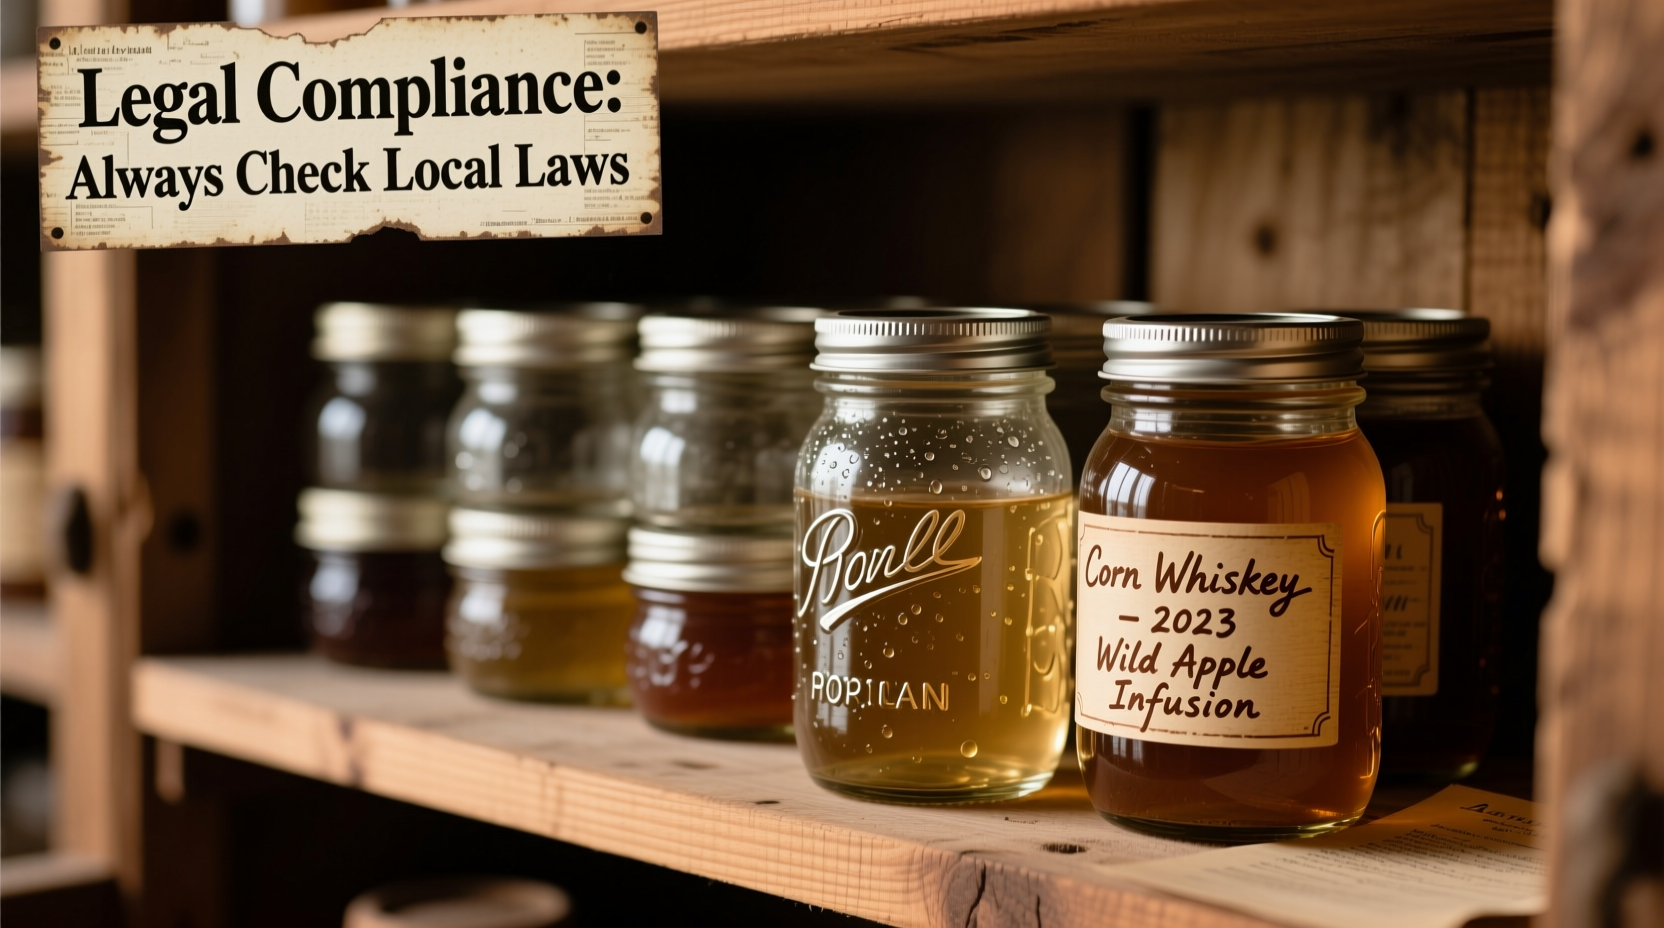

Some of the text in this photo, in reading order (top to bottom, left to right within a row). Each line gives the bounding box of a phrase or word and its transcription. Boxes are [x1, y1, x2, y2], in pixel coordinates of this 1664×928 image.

[78, 56, 622, 142] Legal Compliance:
[65, 143, 630, 212] Always Check Local Laws
[1086, 544, 1313, 617] Corn Whiskey
[1150, 605, 1237, 639] 2023
[1097, 635, 1269, 690] Wild Apple
[1108, 679, 1261, 733] Infusion
